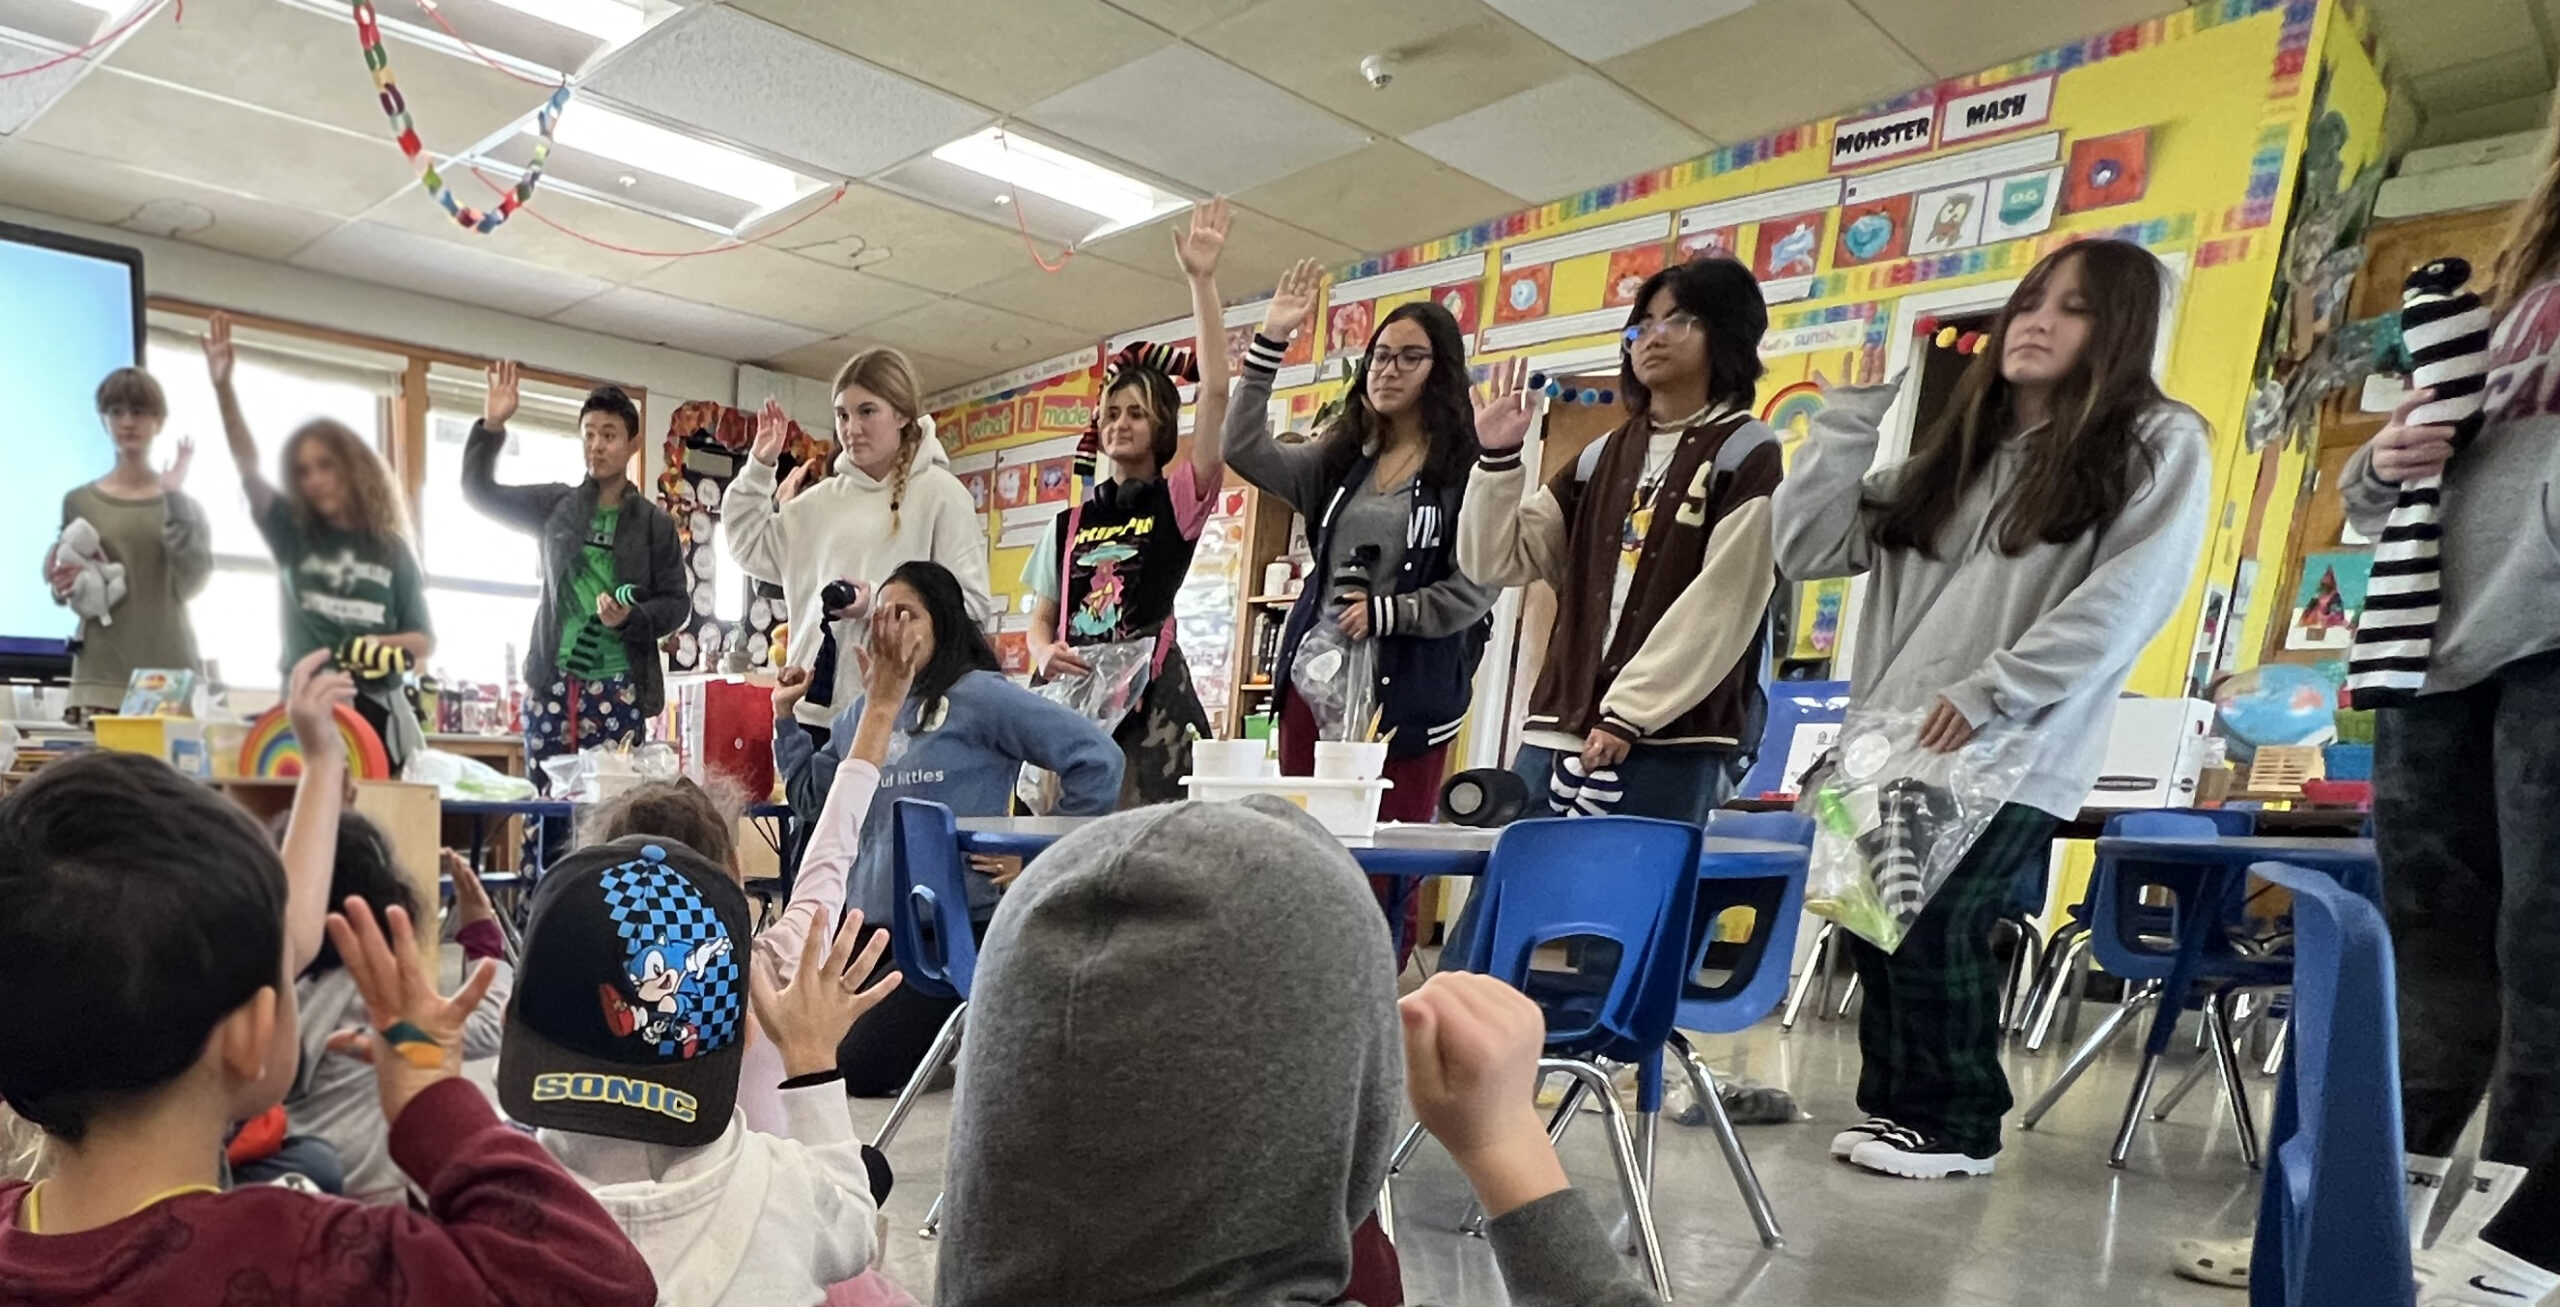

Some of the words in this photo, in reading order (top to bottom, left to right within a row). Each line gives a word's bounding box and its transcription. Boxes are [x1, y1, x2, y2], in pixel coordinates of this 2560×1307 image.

[1836, 117, 1930, 156] MONSTER
[1966, 93, 2027, 128] MASH
[968, 405, 1012, 440] what
[1022, 402, 1033, 430] I
[1042, 399, 1090, 426] made
[897, 768, 944, 786] littles
[532, 1072, 698, 1123] SONIC
